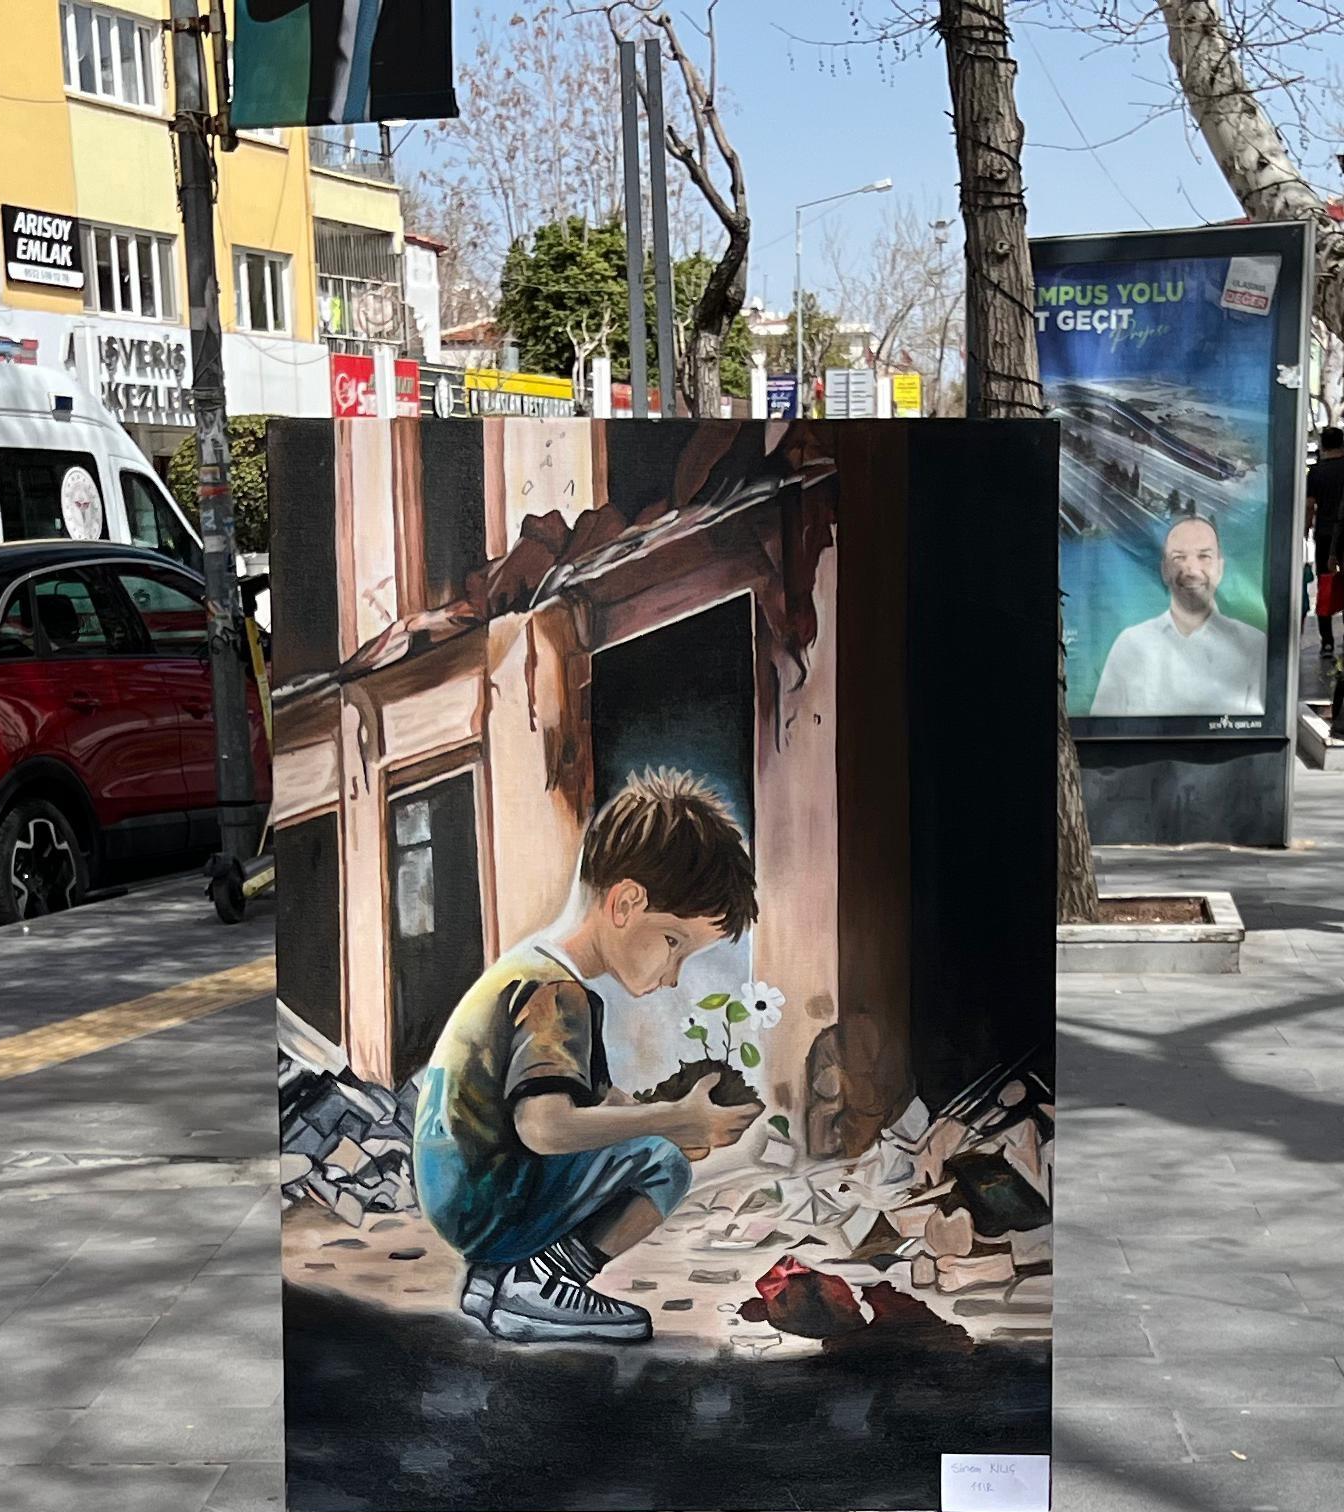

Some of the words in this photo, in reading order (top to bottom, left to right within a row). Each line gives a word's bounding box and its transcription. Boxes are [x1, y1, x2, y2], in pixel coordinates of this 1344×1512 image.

[13, 211, 72, 242] ARISOY
[17, 237, 72, 267] EMLAK
[1117, 281, 1186, 305] YOLU
[1056, 308, 1134, 335] GEÇİT
